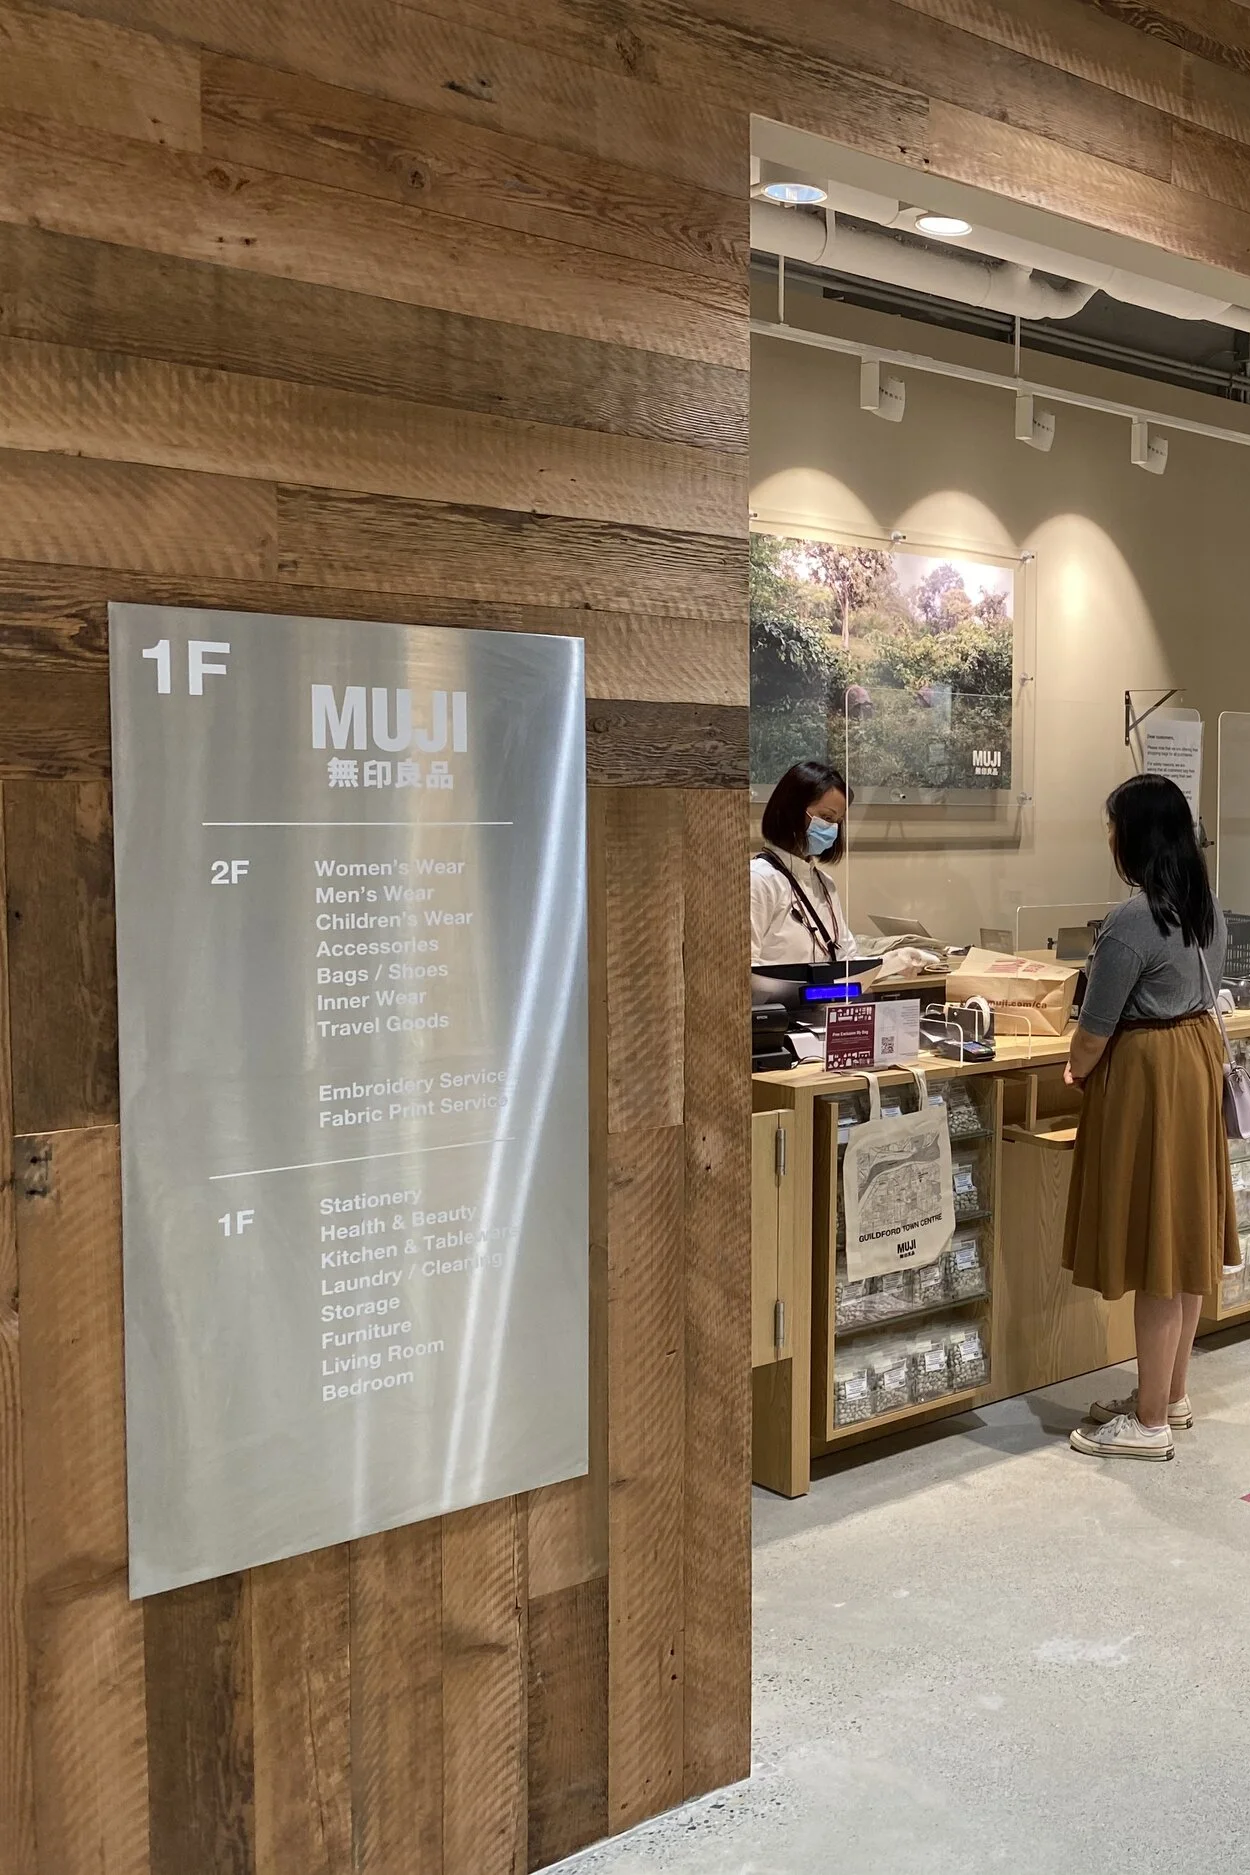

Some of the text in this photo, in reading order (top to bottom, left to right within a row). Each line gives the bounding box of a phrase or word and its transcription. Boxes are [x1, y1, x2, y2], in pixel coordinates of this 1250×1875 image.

[142, 639, 231, 696] 1F
[311, 684, 468, 753] MUJI
[972, 750, 1001, 767] MUJI
[327, 757, 454, 789] 無印良品
[211, 859, 250, 885] 2F
[314, 859, 465, 877] Women's Wear
[315, 885, 434, 904] Men's Wear
[315, 909, 473, 931] Children's Wear
[316, 938, 439, 957] Accessories
[316, 962, 449, 987] Bags / Shoes
[317, 989, 427, 1011] Inner Wear
[317, 1012, 449, 1038] Travel Goods
[319, 1068, 506, 1101] Embroidery Service
[319, 1094, 508, 1128] Fabric Print Service
[319, 1188, 422, 1215] Stationery
[218, 1210, 255, 1236] 1F
[320, 1204, 477, 1242] Health & Beauty
[858, 1212, 943, 1243] GUILDFORD TOWN CENTRE
[321, 1244, 397, 1269] Kitchen
[404, 1239, 417, 1254] &
[897, 1239, 917, 1254] MUJI
[321, 1268, 403, 1296] Laundry
[321, 1296, 400, 1322] Storage
[321, 1320, 412, 1349] Furniture
[322, 1339, 445, 1376] Living Room
[322, 1371, 414, 1402] Bedroom
